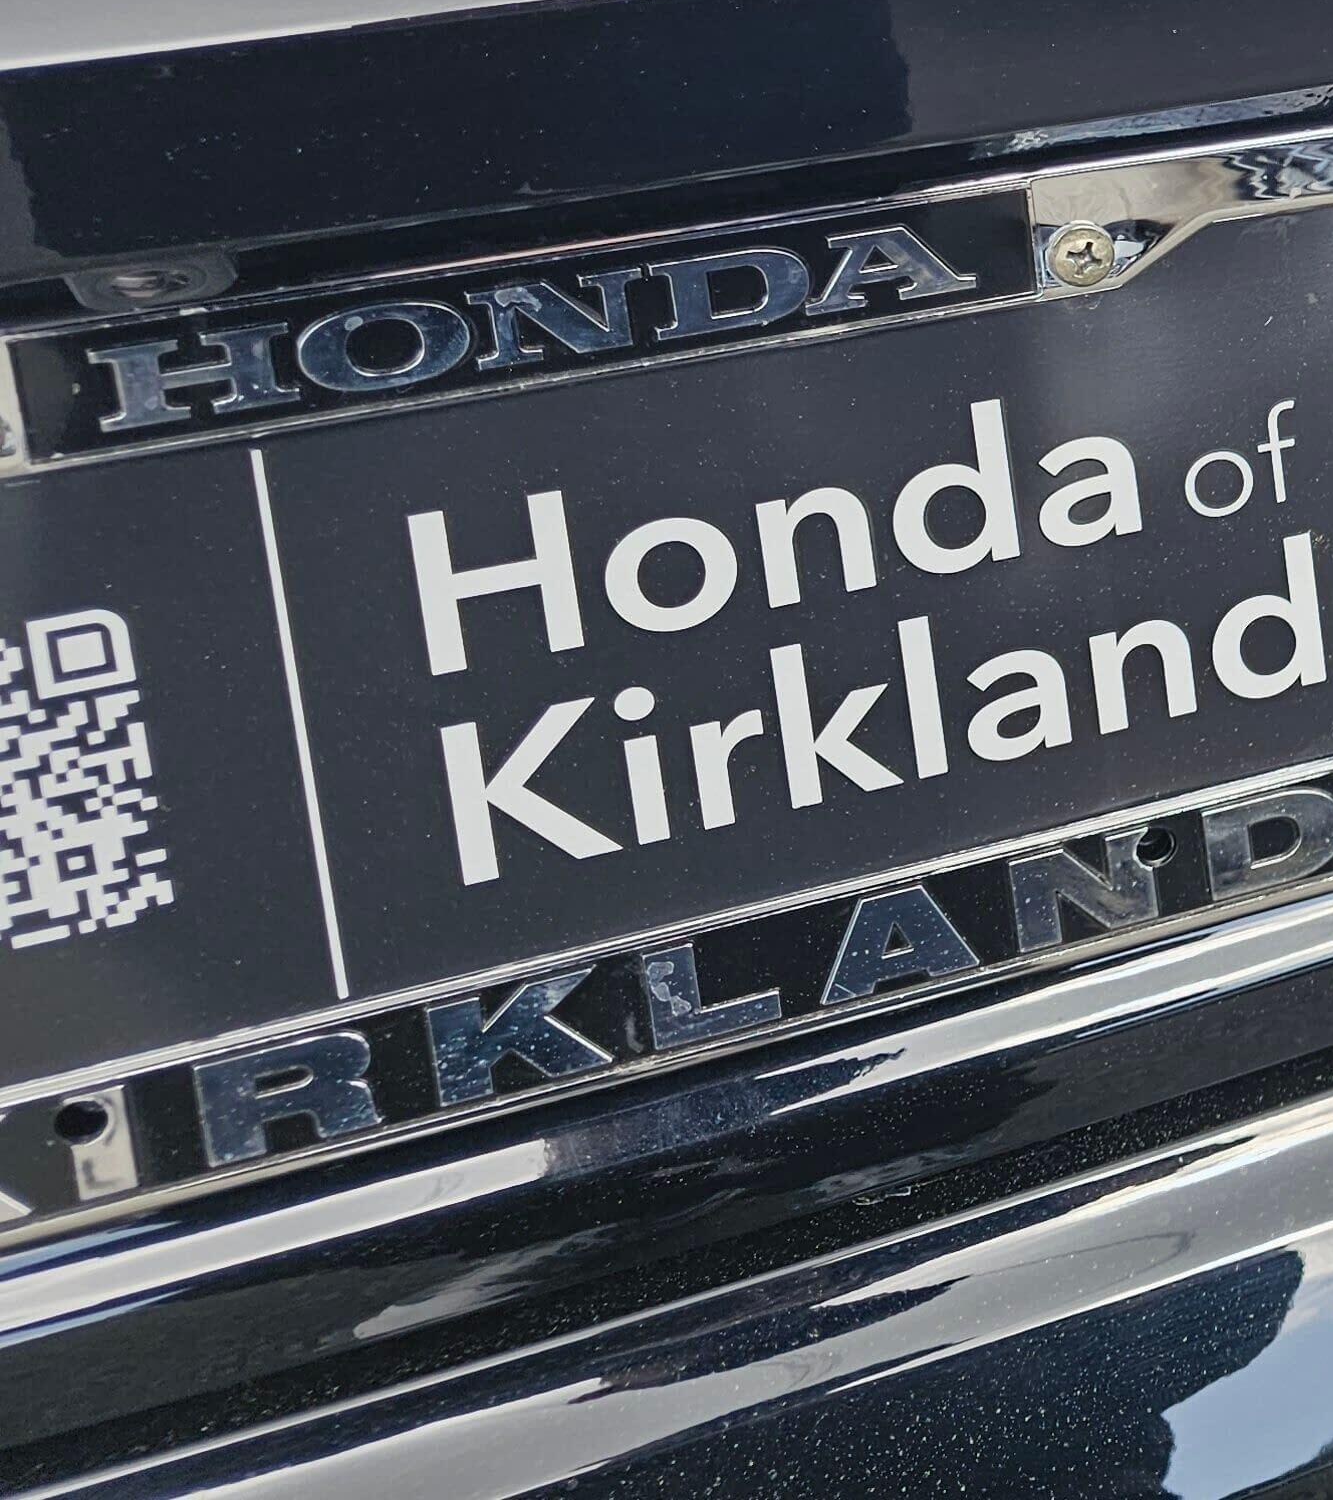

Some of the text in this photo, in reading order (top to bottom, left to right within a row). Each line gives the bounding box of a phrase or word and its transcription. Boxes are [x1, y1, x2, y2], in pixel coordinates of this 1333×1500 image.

[89, 224, 978, 432] HONDA
[407, 398, 1295, 676] Honda of
[438, 532, 1328, 886] Kirkland
